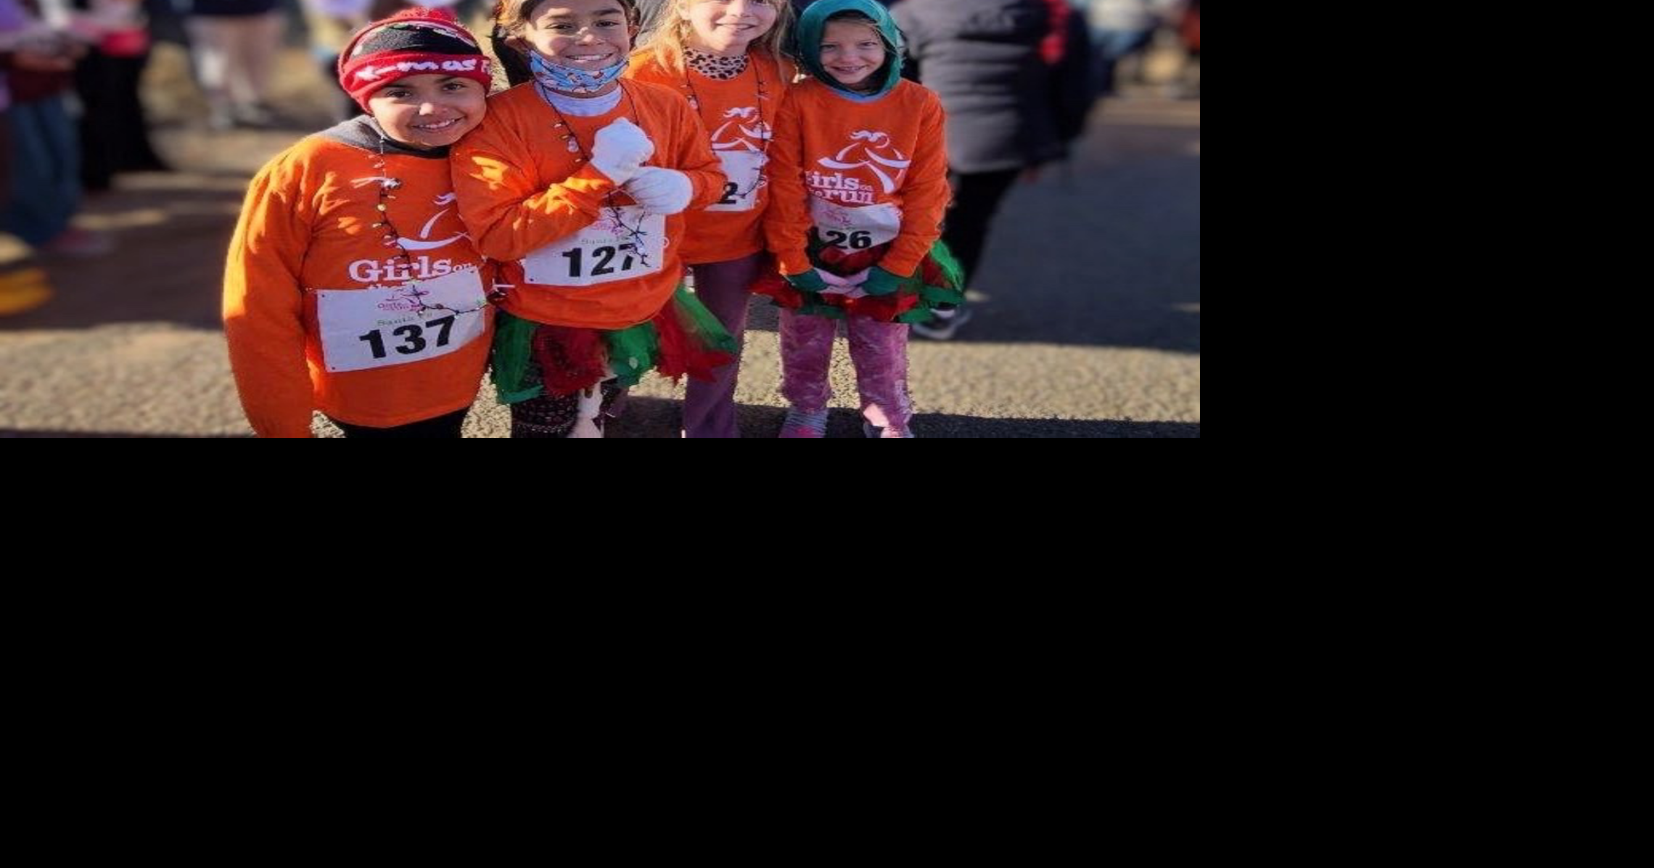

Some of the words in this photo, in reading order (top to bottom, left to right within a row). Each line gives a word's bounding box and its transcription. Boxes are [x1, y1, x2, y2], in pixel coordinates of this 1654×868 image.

[823, 189, 874, 204] run
[826, 230, 872, 249] 26
[349, 255, 451, 283] Girls
[562, 243, 636, 277] 127
[359, 315, 456, 359] 137
